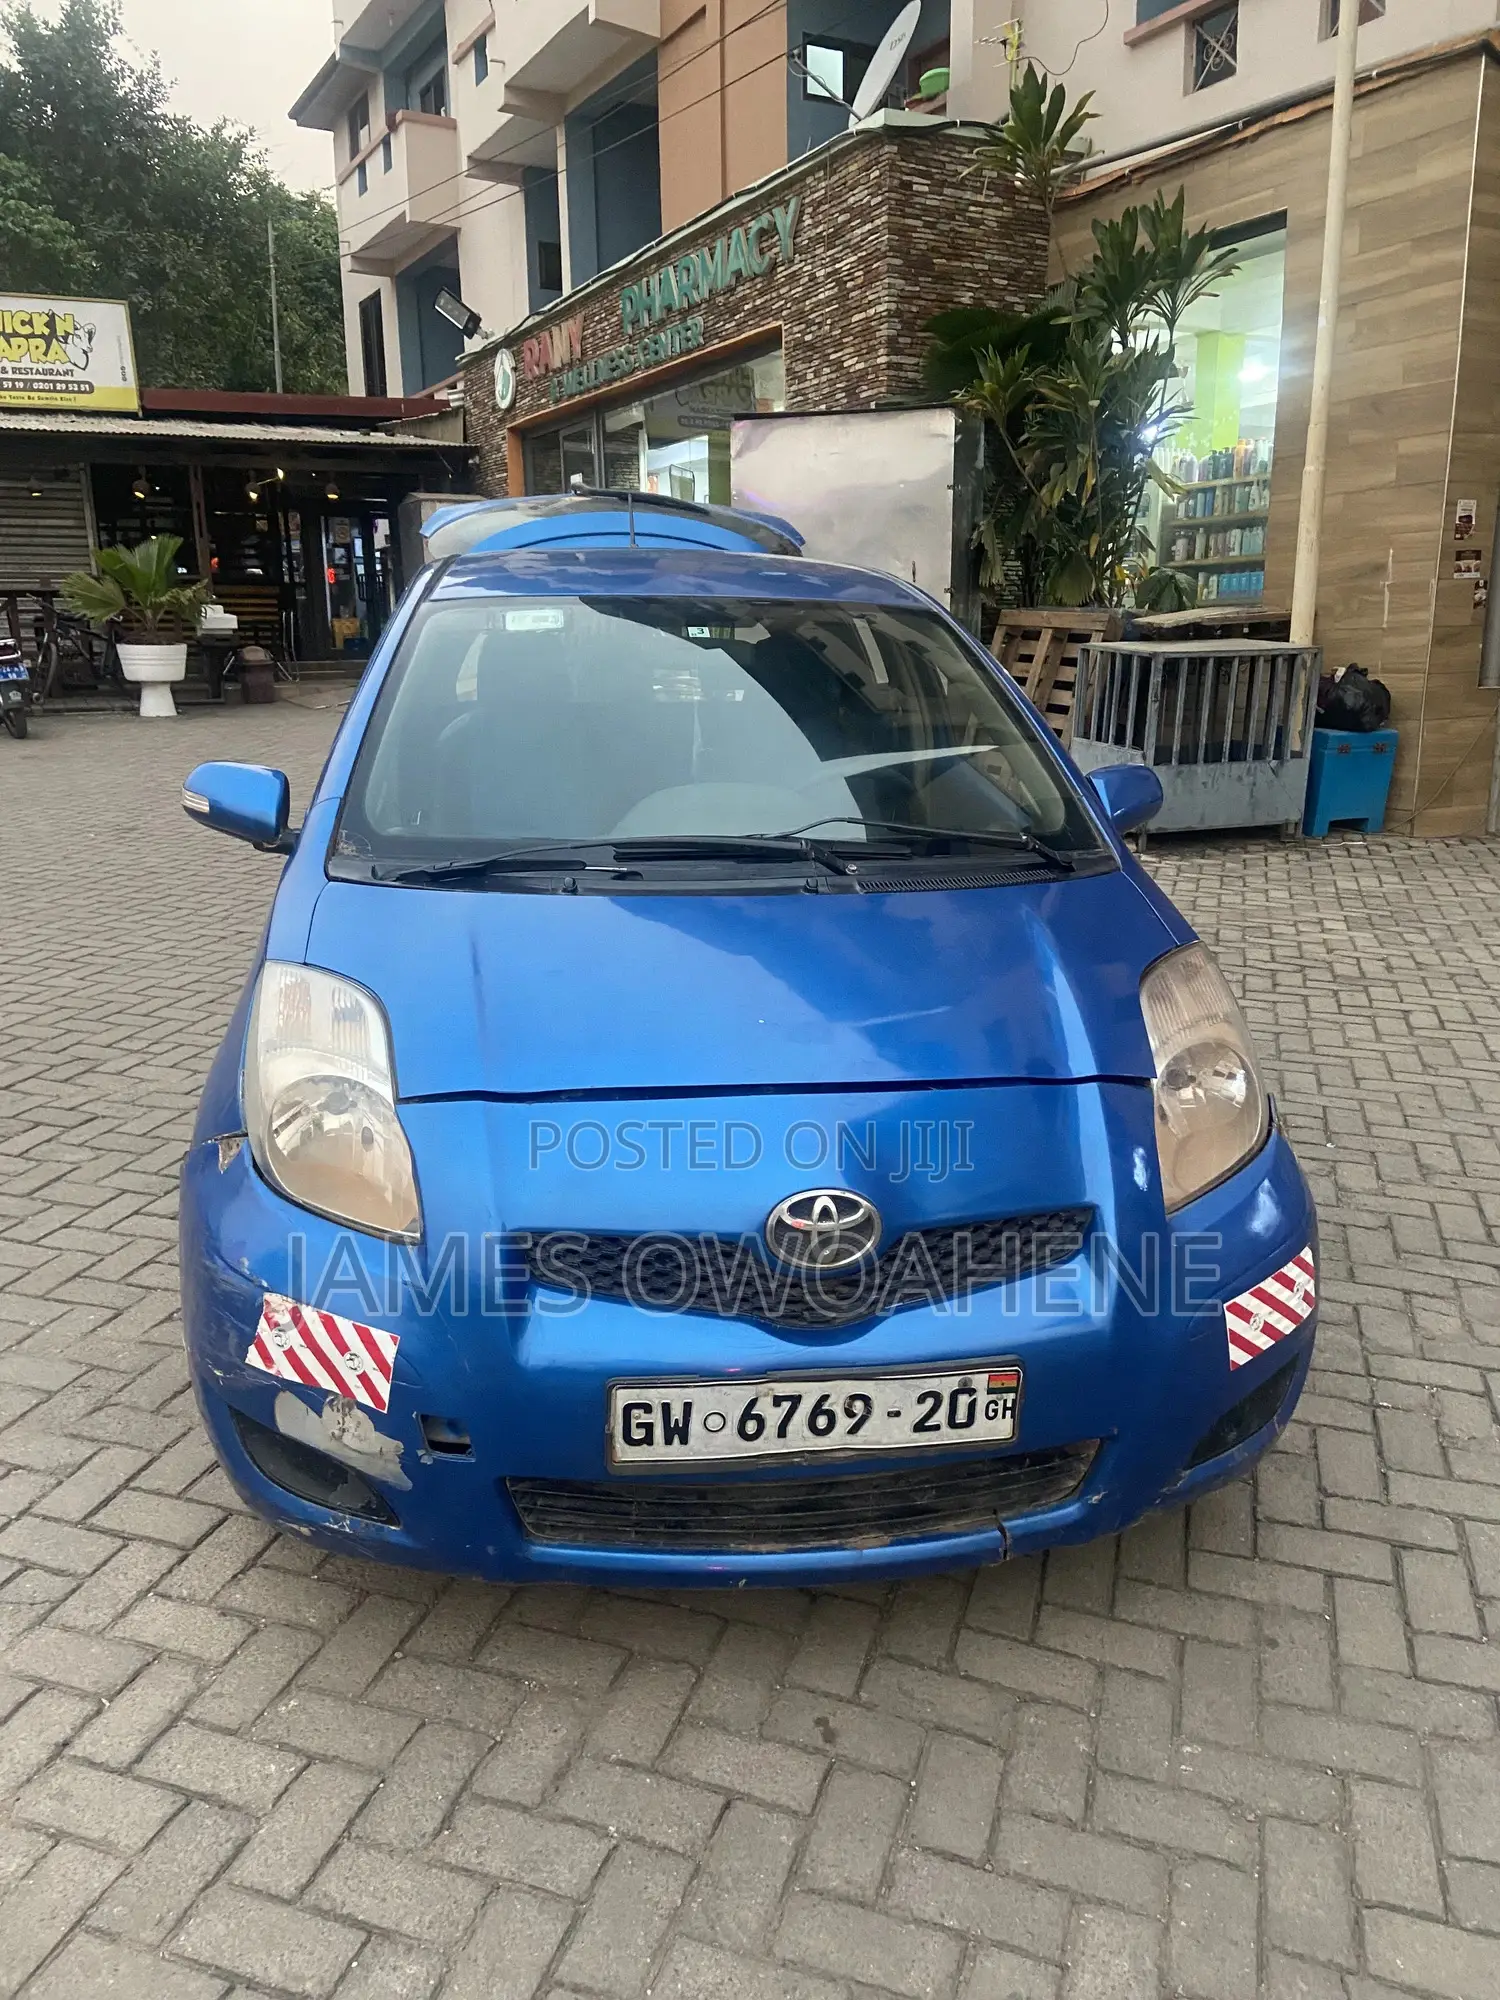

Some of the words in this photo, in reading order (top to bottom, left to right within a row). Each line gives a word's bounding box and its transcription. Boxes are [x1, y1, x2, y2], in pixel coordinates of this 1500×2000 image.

[620, 197, 799, 335] PHARMACY
[0, 310, 50, 335] ICK
[563, 343, 635, 396] WELLNESS
[637, 316, 705, 369] CENTER
[1, 366, 8, 374] &
[11, 366, 74, 377] RESTAURANT
[33, 382, 53, 390] 0201
[984, 1398, 1017, 1421] GH
[622, 1401, 693, 1446] GW
